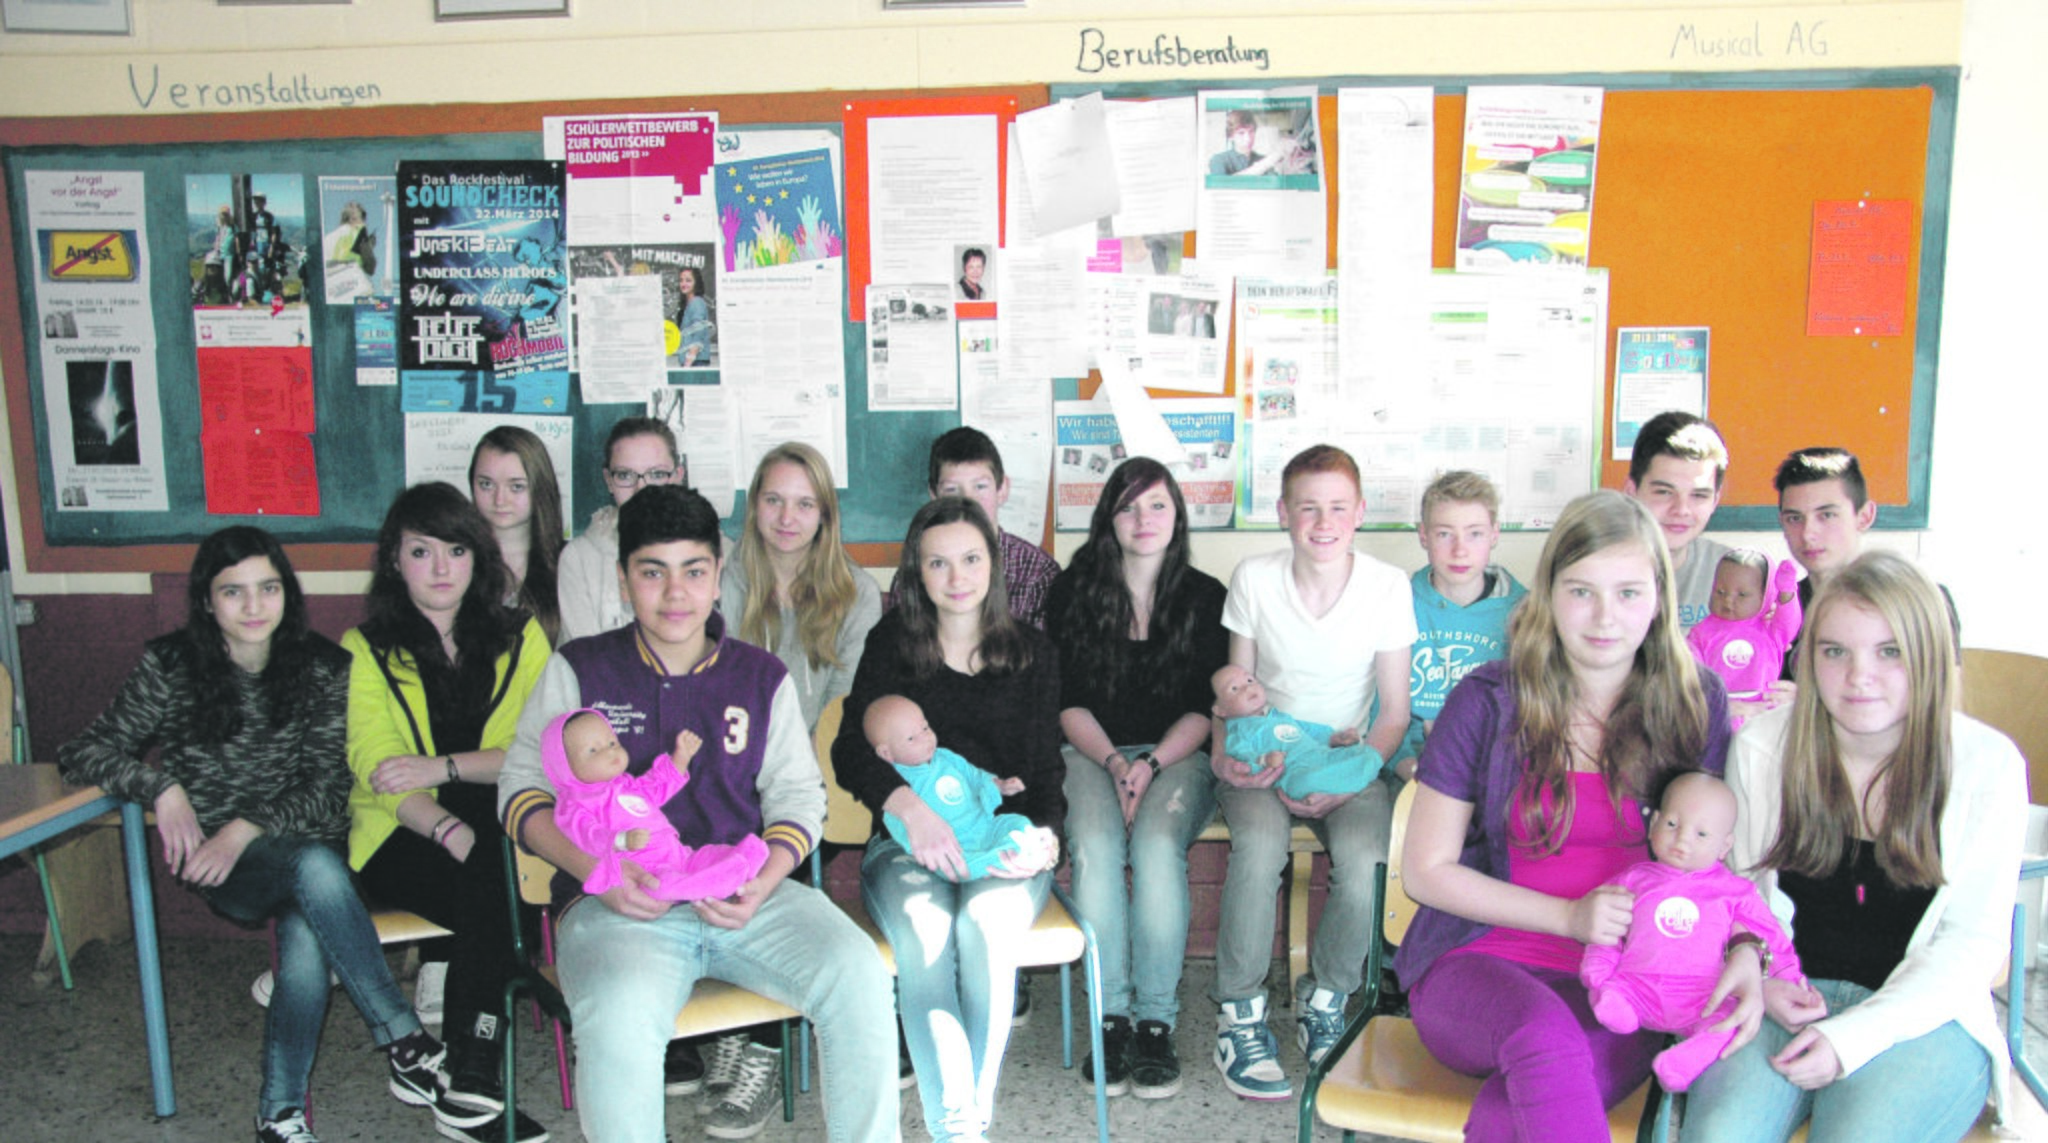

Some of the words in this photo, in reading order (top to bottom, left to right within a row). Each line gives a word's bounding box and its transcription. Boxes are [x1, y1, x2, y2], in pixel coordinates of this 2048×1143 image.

[1669, 20, 1763, 59] Musical
[1785, 19, 1828, 56] AG
[1076, 27, 1270, 73] Berufsberatung
[127, 63, 382, 110] Veranstaltungen
[566, 119, 699, 136] SCHÜLERWETTBEWERB
[567, 138, 590, 149] ZUR
[593, 135, 665, 149] POLITISCHEN
[568, 151, 619, 164] BILDUNG
[422, 174, 446, 185] Das
[450, 173, 525, 186] Rockfestival
[52, 188, 67, 196] vor
[70, 187, 87, 196] der
[405, 185, 560, 208] SOUNDCHECK
[413, 216, 430, 225] mit
[529, 209, 560, 219] 2014
[65, 245, 116, 265] Angst
[413, 267, 500, 279] UNDERCLASS
[502, 266, 557, 279] HEROES
[450, 292, 479, 307] are
[481, 285, 535, 307] divine
[1059, 417, 1082, 428] Wir
[1087, 416, 1118, 427] habe
[1174, 428, 1220, 439] ssistenten
[1419, 630, 1499, 651] OUTHSHORE
[723, 705, 749, 755] 3
